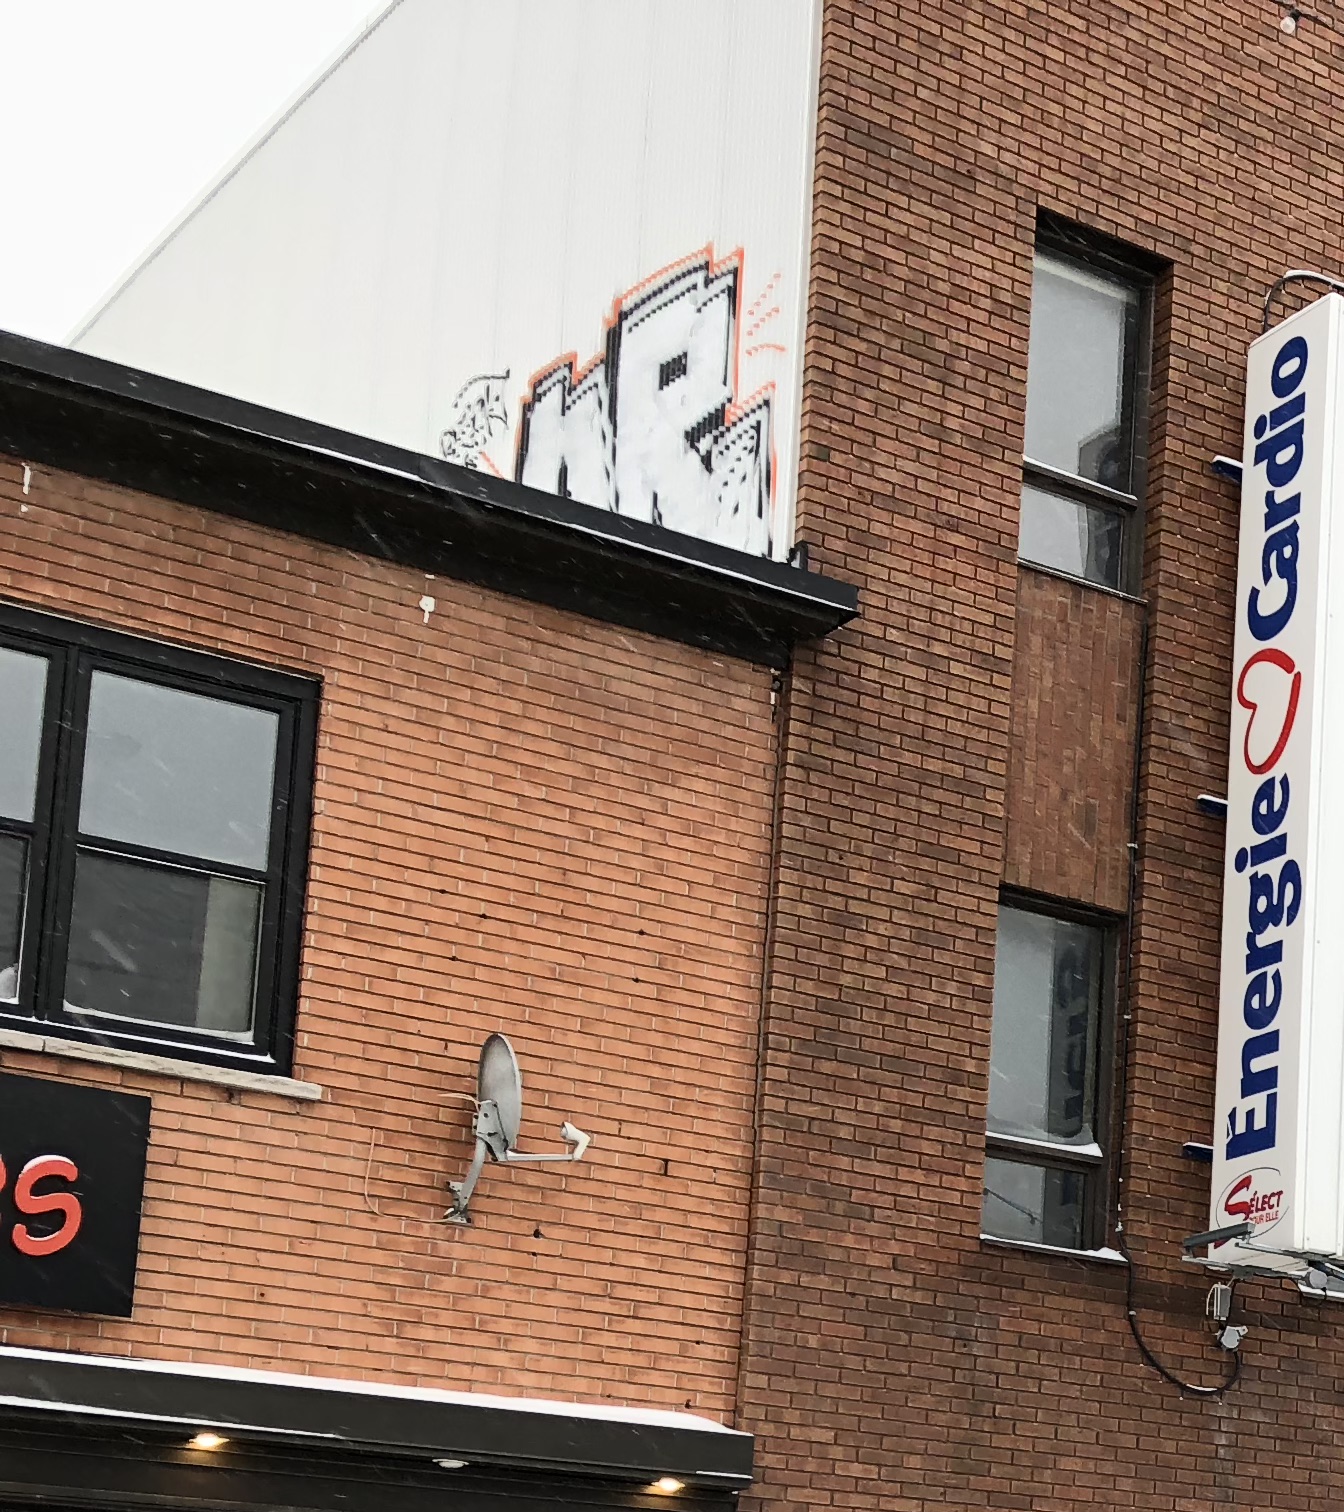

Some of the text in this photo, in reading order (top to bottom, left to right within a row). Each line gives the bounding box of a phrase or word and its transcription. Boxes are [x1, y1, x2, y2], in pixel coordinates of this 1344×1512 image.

[1227, 337, 1309, 1160] Énergie Cardio
[0, 1155, 82, 1256] S
